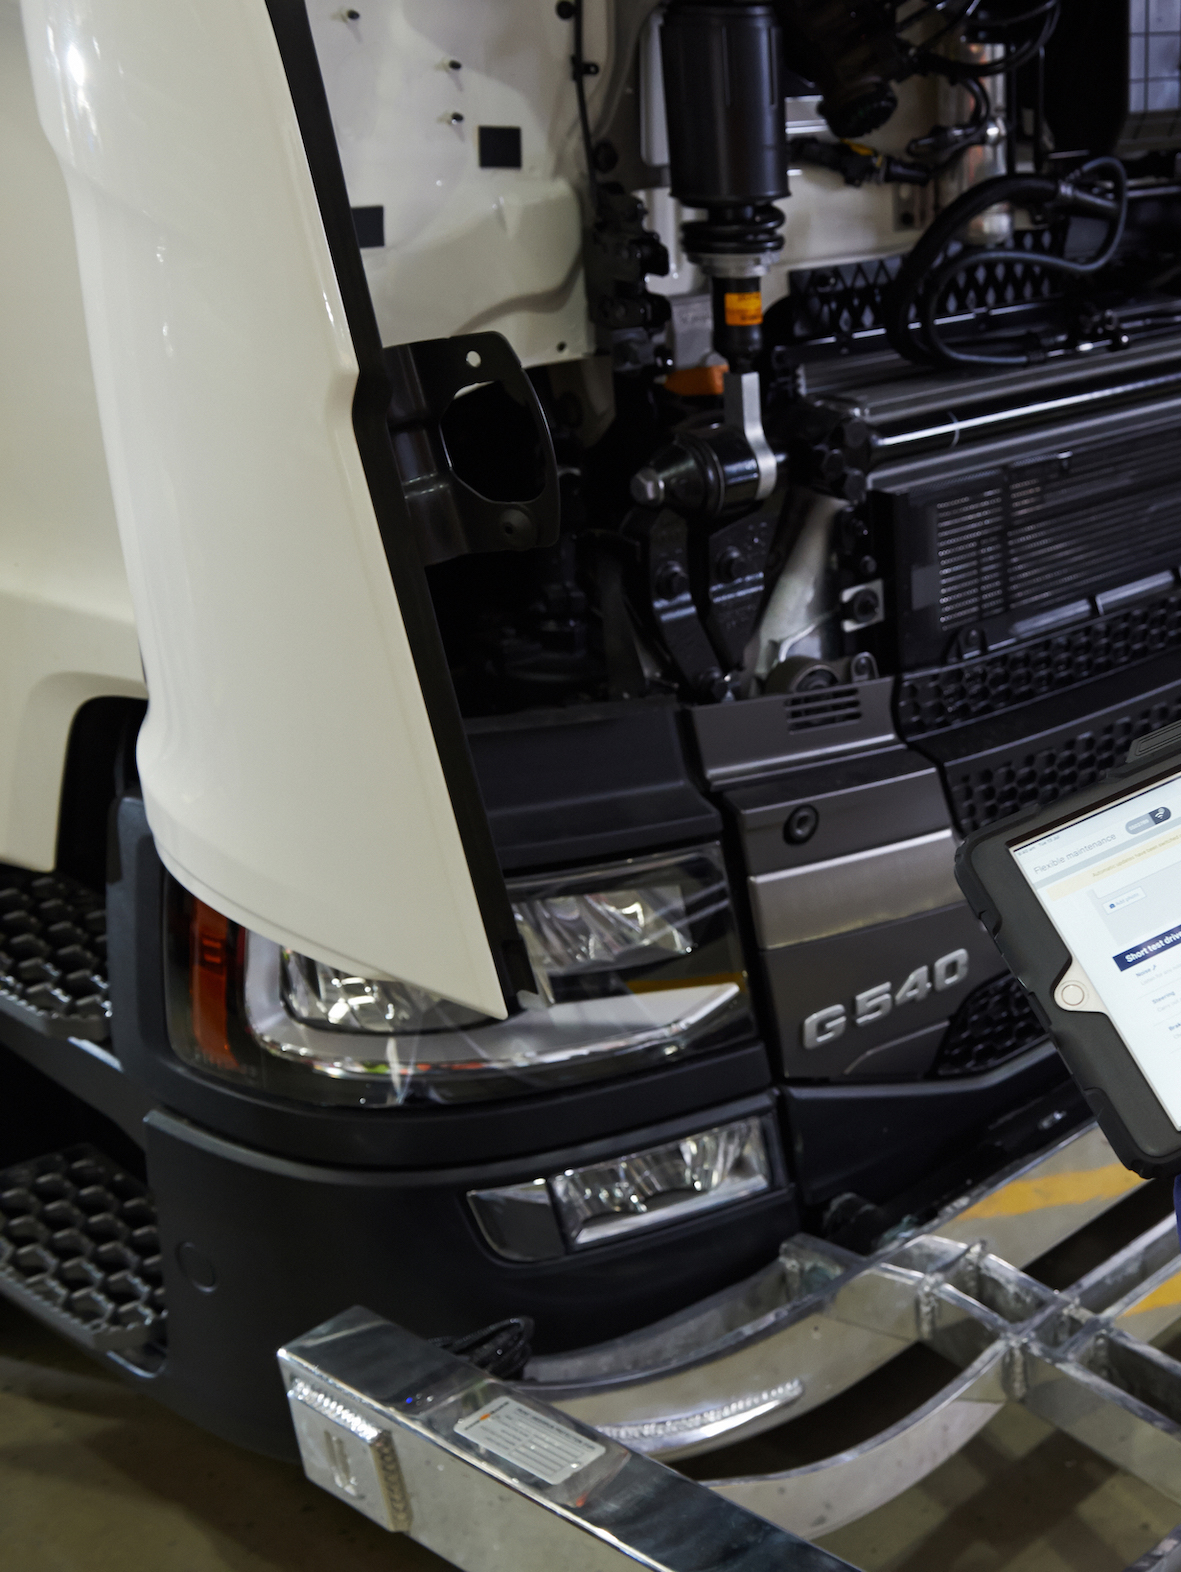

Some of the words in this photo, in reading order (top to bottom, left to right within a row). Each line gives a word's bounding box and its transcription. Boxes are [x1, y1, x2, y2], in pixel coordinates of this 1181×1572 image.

[1033, 855, 1066, 875] Flexible
[1065, 832, 1117, 860] maintenance
[1125, 947, 1149, 963] Short
[1147, 939, 1165, 952] test
[1136, 968, 1151, 978] Noise
[803, 1003, 848, 1050] G
[855, 948, 970, 1027] 540
[1152, 990, 1176, 1005] Steering
